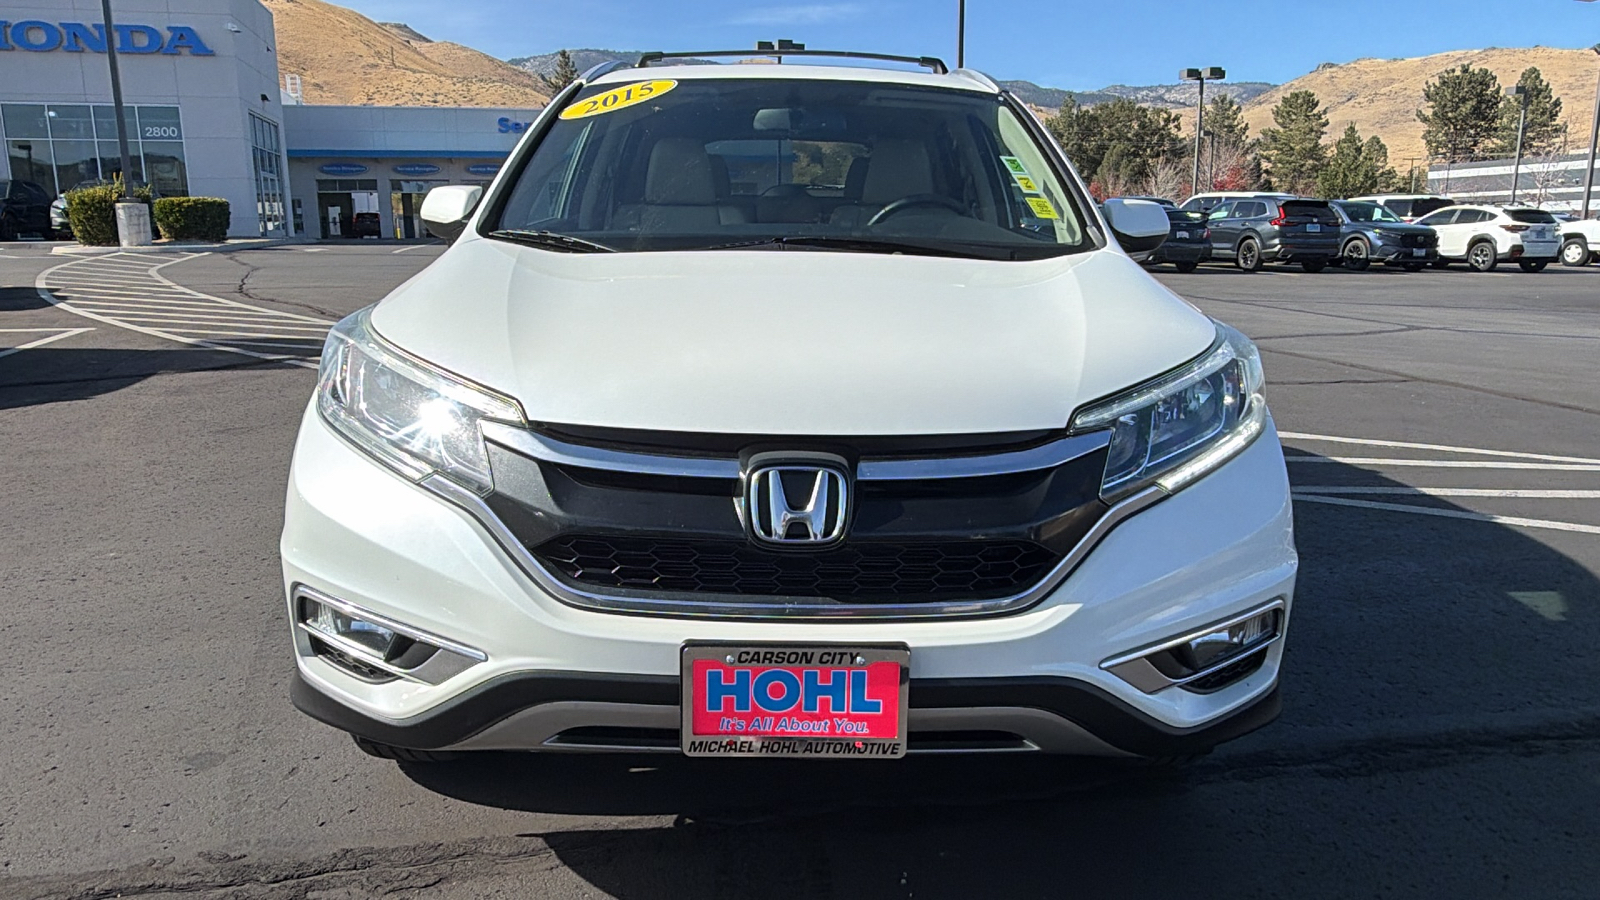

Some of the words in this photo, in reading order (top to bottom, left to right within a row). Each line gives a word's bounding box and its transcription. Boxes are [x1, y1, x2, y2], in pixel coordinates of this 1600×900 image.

[0, 20, 215, 56] ONDA
[583, 82, 654, 114] 2015
[145, 126, 178, 138] 2800
[737, 651, 815, 665] CARSON
[818, 651, 861, 665] CITY
[706, 668, 883, 714] HOHL
[719, 717, 746, 731] It's
[749, 717, 773, 731] All
[776, 717, 830, 733] About
[834, 718, 869, 734] You.
[688, 740, 755, 754] MICHAEL
[759, 741, 799, 754] HOHL
[802, 741, 901, 755] AUTOMOTIVE
